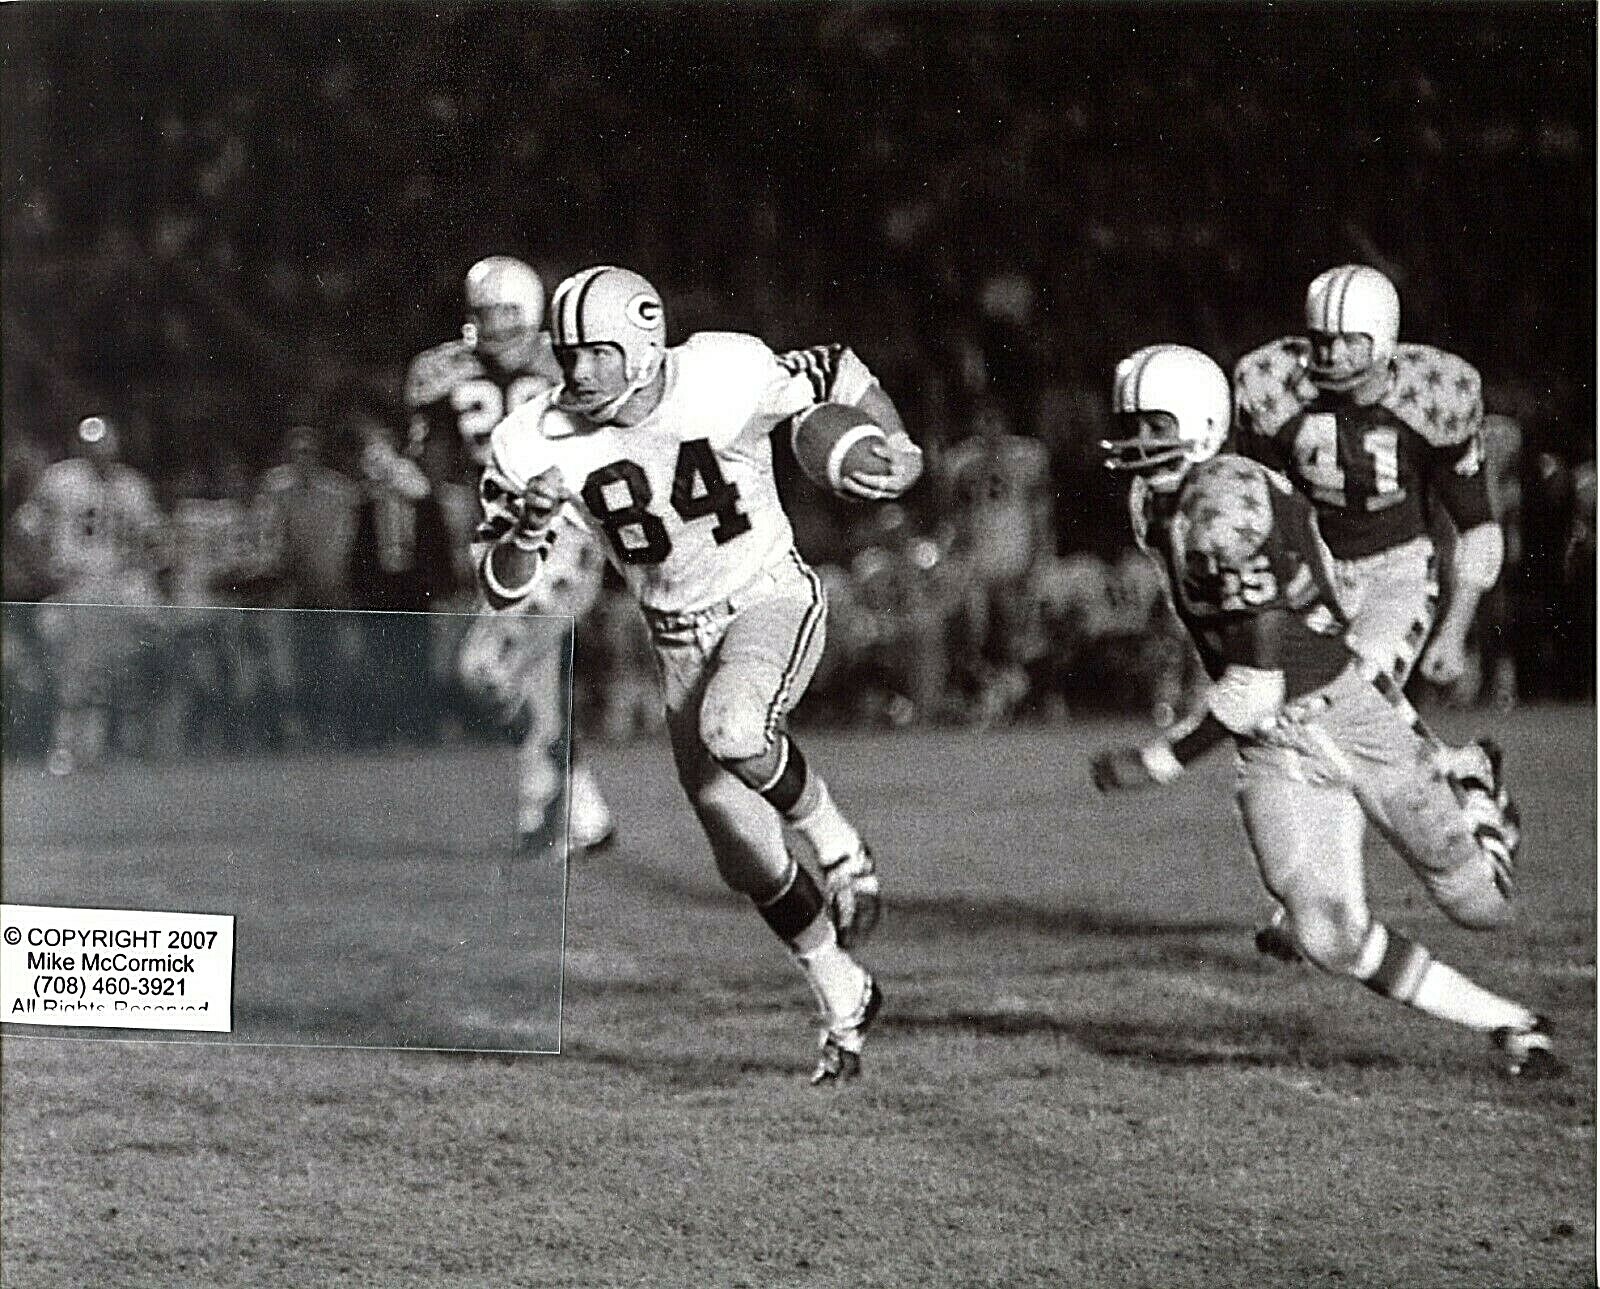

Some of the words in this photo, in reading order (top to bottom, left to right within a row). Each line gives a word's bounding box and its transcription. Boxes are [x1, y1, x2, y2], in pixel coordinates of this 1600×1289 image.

[626, 294, 662, 330] G
[581, 437, 752, 565] 84
[1295, 412, 1405, 512] 41
